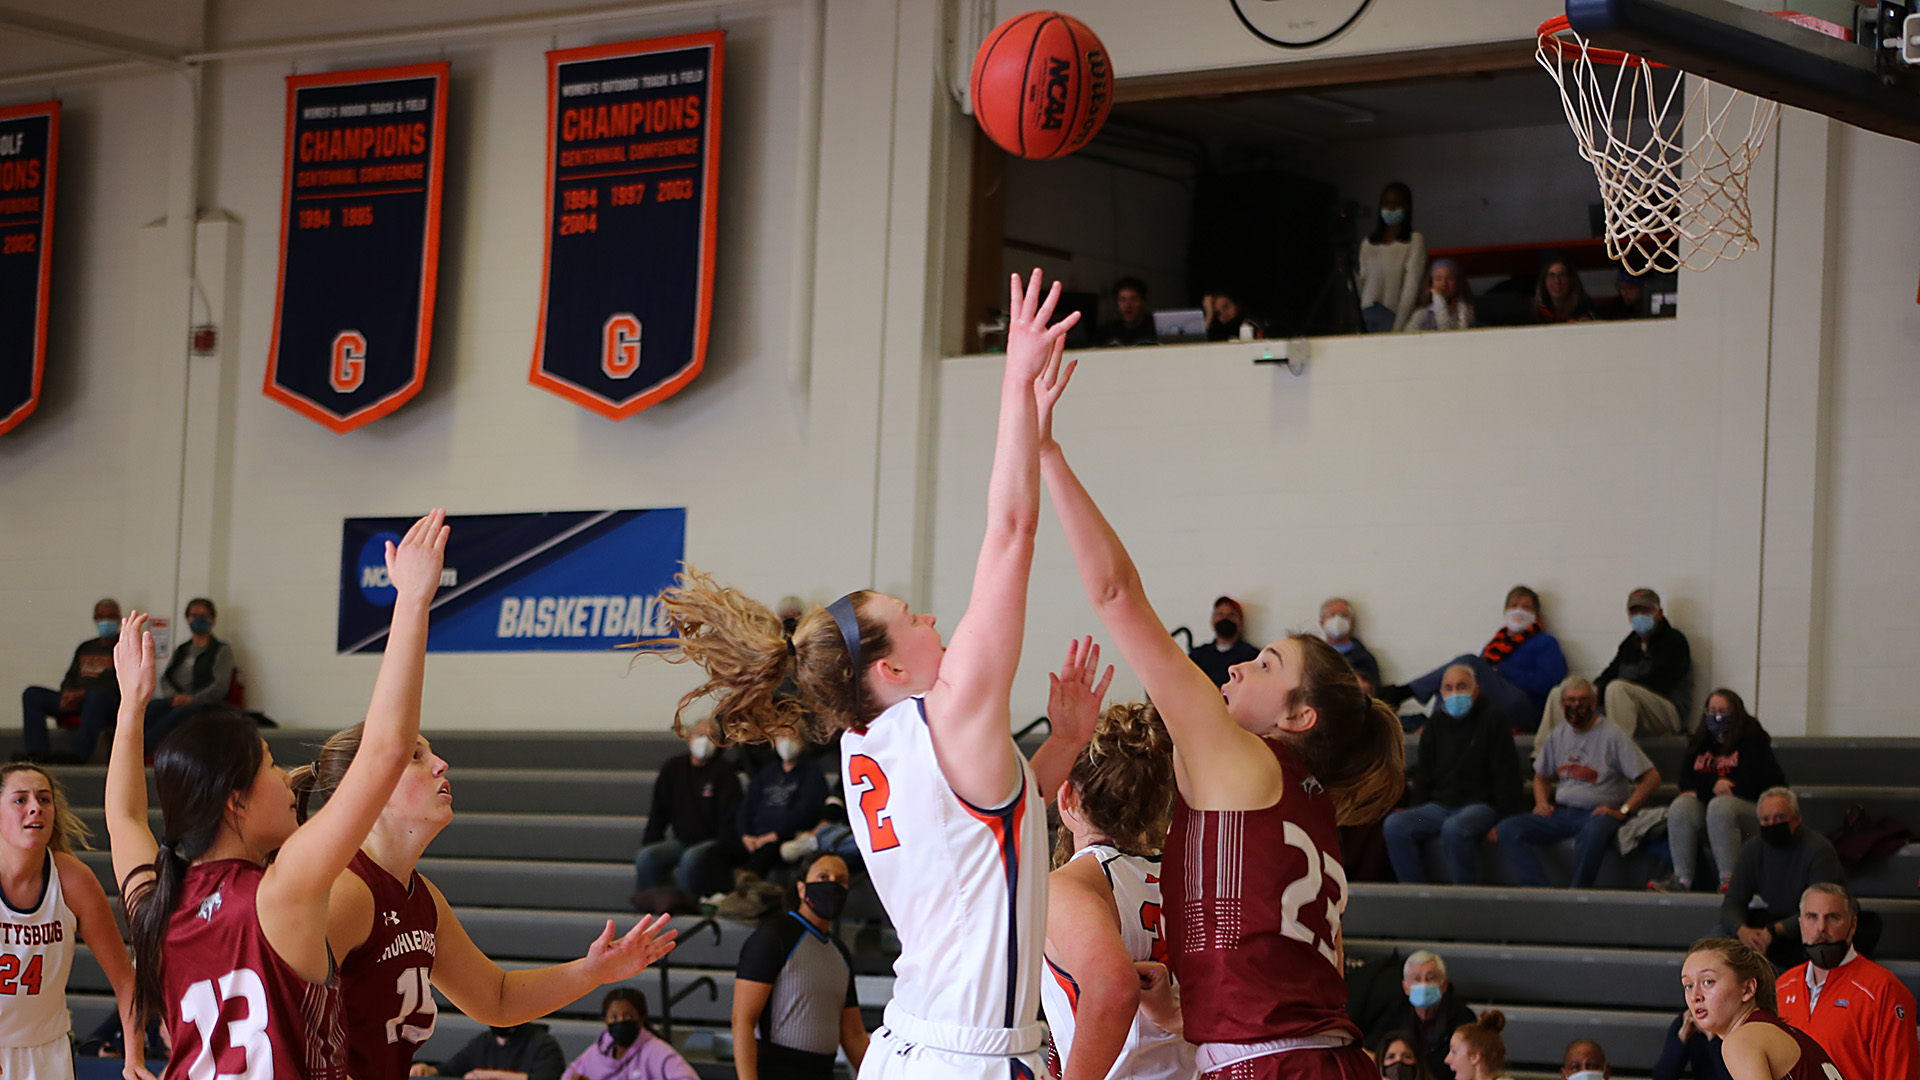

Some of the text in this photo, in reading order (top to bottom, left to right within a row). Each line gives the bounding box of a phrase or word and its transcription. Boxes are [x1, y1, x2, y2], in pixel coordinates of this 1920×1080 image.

[561, 82, 598, 97] WOMEN'S
[601, 78, 638, 93] OUTDOOR
[642, 73, 668, 88] TRACK
[681, 69, 703, 83] FIELD
[1041, 56, 1070, 130] NCAA
[304, 106, 337, 119] WOMEN'S
[369, 101, 395, 114] TRACK
[405, 98, 426, 111] FIELD
[562, 95, 700, 142] CHAMPIONS
[300, 122, 426, 163] CHAMPIONS
[560, 137, 698, 167] CENTENNIAL CONFERENCE
[297, 163, 424, 187] CENTENNIAL CONFERENCE
[563, 178, 693, 210] 1994 1997 2003
[299, 205, 374, 229] 1994 1995
[558, 213, 597, 236] 2004
[3, 234, 36, 254] 2002
[330, 329, 367, 394] G
[602, 313, 642, 379] G
[849, 754, 900, 853] 2
[1279, 820, 1349, 970] 23
[0, 953, 43, 995] 24
[180, 967, 274, 1080] 13
